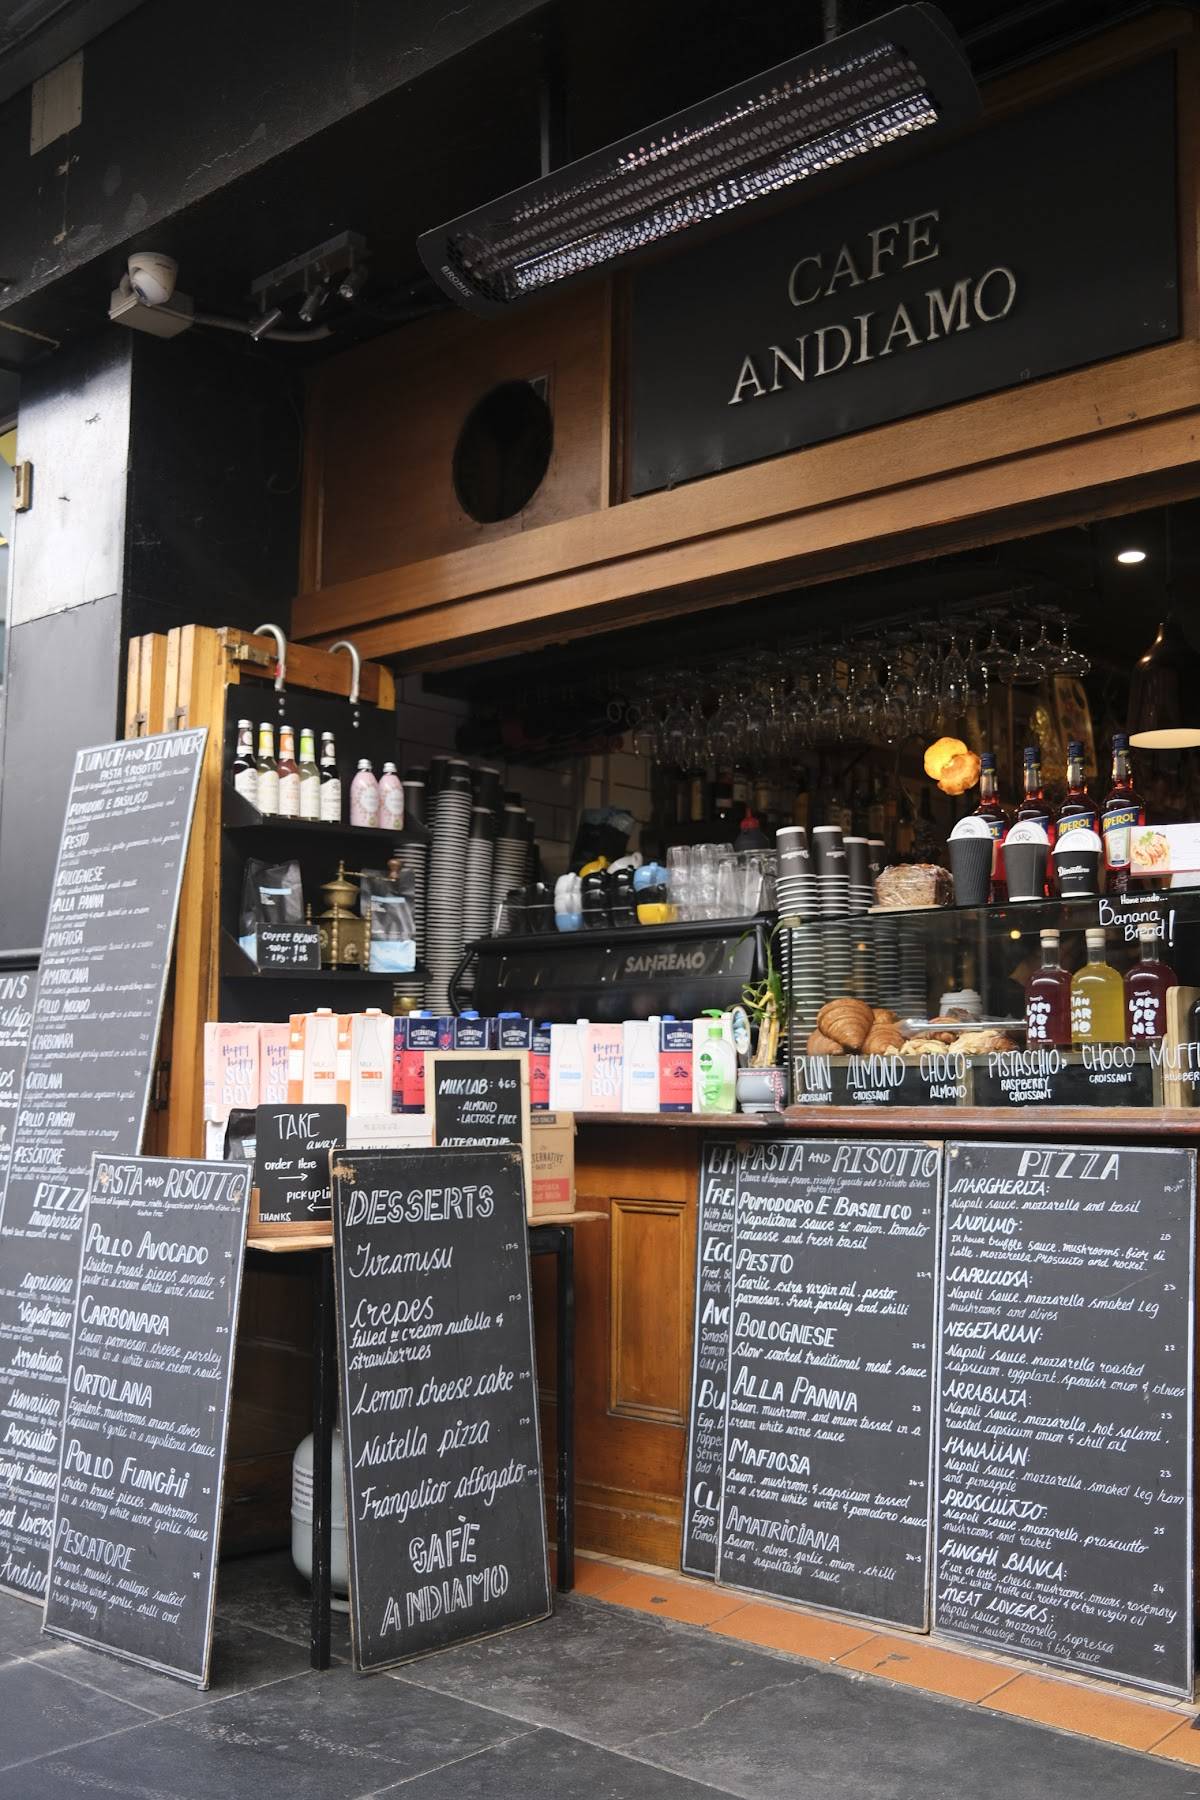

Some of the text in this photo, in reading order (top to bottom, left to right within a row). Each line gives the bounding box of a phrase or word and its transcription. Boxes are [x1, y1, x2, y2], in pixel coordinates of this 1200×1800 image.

[788, 210, 940, 306] CAFE
[728, 267, 1016, 404] ANDIAMO
[76, 747, 124, 774] LUNCH
[144, 736, 201, 761] DINNER
[1058, 817, 1092, 834] APEROL
[1103, 813, 1135, 829] APEROL
[62, 832, 90, 850] PESTO
[56, 866, 105, 886] BOLOGNESE
[51, 896, 75, 912] ALLA
[1099, 899, 1161, 926] Banana
[262, 932, 318, 943] COFFEE BEANS
[625, 952, 706, 973] SANREMO
[794, 1055, 832, 1090] PLAIN
[846, 1054, 905, 1089] ALMOND
[920, 1052, 966, 1082] CHOCO
[1082, 1044, 1136, 1072] CHOCO
[1089, 1072, 1132, 1083] CROISSANT
[797, 1092, 832, 1102] CROISSANT
[853, 1089, 890, 1100] CROISSANT
[930, 1084, 967, 1099] ALMOND
[1001, 1076, 1050, 1091] RASPBERRY
[1009, 1089, 1052, 1101] CROISSANT
[461, 1114, 518, 1125] LACTOSE FREE
[462, 1101, 498, 1113] ALMOND
[273, 1113, 320, 1140] TAKE
[741, 1145, 939, 1178] PASTA AND RISOTTO
[1017, 1150, 1120, 1181] PIZZA
[92, 1163, 143, 1196] PASTA
[144, 1177, 164, 1188] AND
[164, 1168, 246, 1202] RISOTTO
[259, 1212, 292, 1222] THANKS
[346, 1185, 494, 1227] DESSERTS
[738, 1192, 912, 1220] POMODORO E BASILICO
[950, 1198, 983, 1213] Napoli
[1021, 1199, 1080, 1212] mozzarella
[1083, 1201, 1105, 1212] and
[1108, 1199, 1141, 1213] basil
[737, 1212, 797, 1229] Napolitana
[800, 1215, 834, 1231] sauce
[888, 1223, 930, 1237] tomato
[85, 1223, 132, 1257] POLLO
[136, 1231, 209, 1265] AVOCADO
[782, 1232, 803, 1244] and
[806, 1234, 834, 1247] fresh
[836, 1235, 868, 1250] basil
[349, 1242, 453, 1278] Tiramisu
[736, 1248, 794, 1274] PESTO
[80, 1294, 170, 1337] CARBONARA
[350, 1296, 434, 1329] Crepes
[1006, 1307, 1025, 1319] and
[1028, 1309, 1058, 1321] olives
[401, 1322, 443, 1342] cream
[444, 1312, 490, 1336] nutella
[735, 1312, 838, 1347] BOLOGNESE
[349, 1344, 431, 1370] strawberries
[803, 1351, 860, 1371] traditional
[865, 1362, 891, 1374] meat
[895, 1366, 927, 1378] sauce
[73, 1365, 153, 1408] ORTOLANA
[352, 1365, 514, 1416] Lemon cheese cake
[732, 1365, 858, 1413] ALLA PANNA
[355, 1420, 490, 1468] Nutella pizza
[728, 1438, 811, 1475] MAFIOSA
[64, 1439, 114, 1479] POLLO
[359, 1458, 527, 1524] Frangelico affogato
[943, 1474, 1017, 1493] and pineapple
[725, 1505, 840, 1552] AMATRICIANA
[1153, 1526, 1165, 1535] 25
[55, 1518, 136, 1572] PESCATORE
[380, 1564, 509, 1637] ANDIAMO
[939, 1587, 983, 1608] MEAT
[1153, 1583, 1164, 1594] 24
